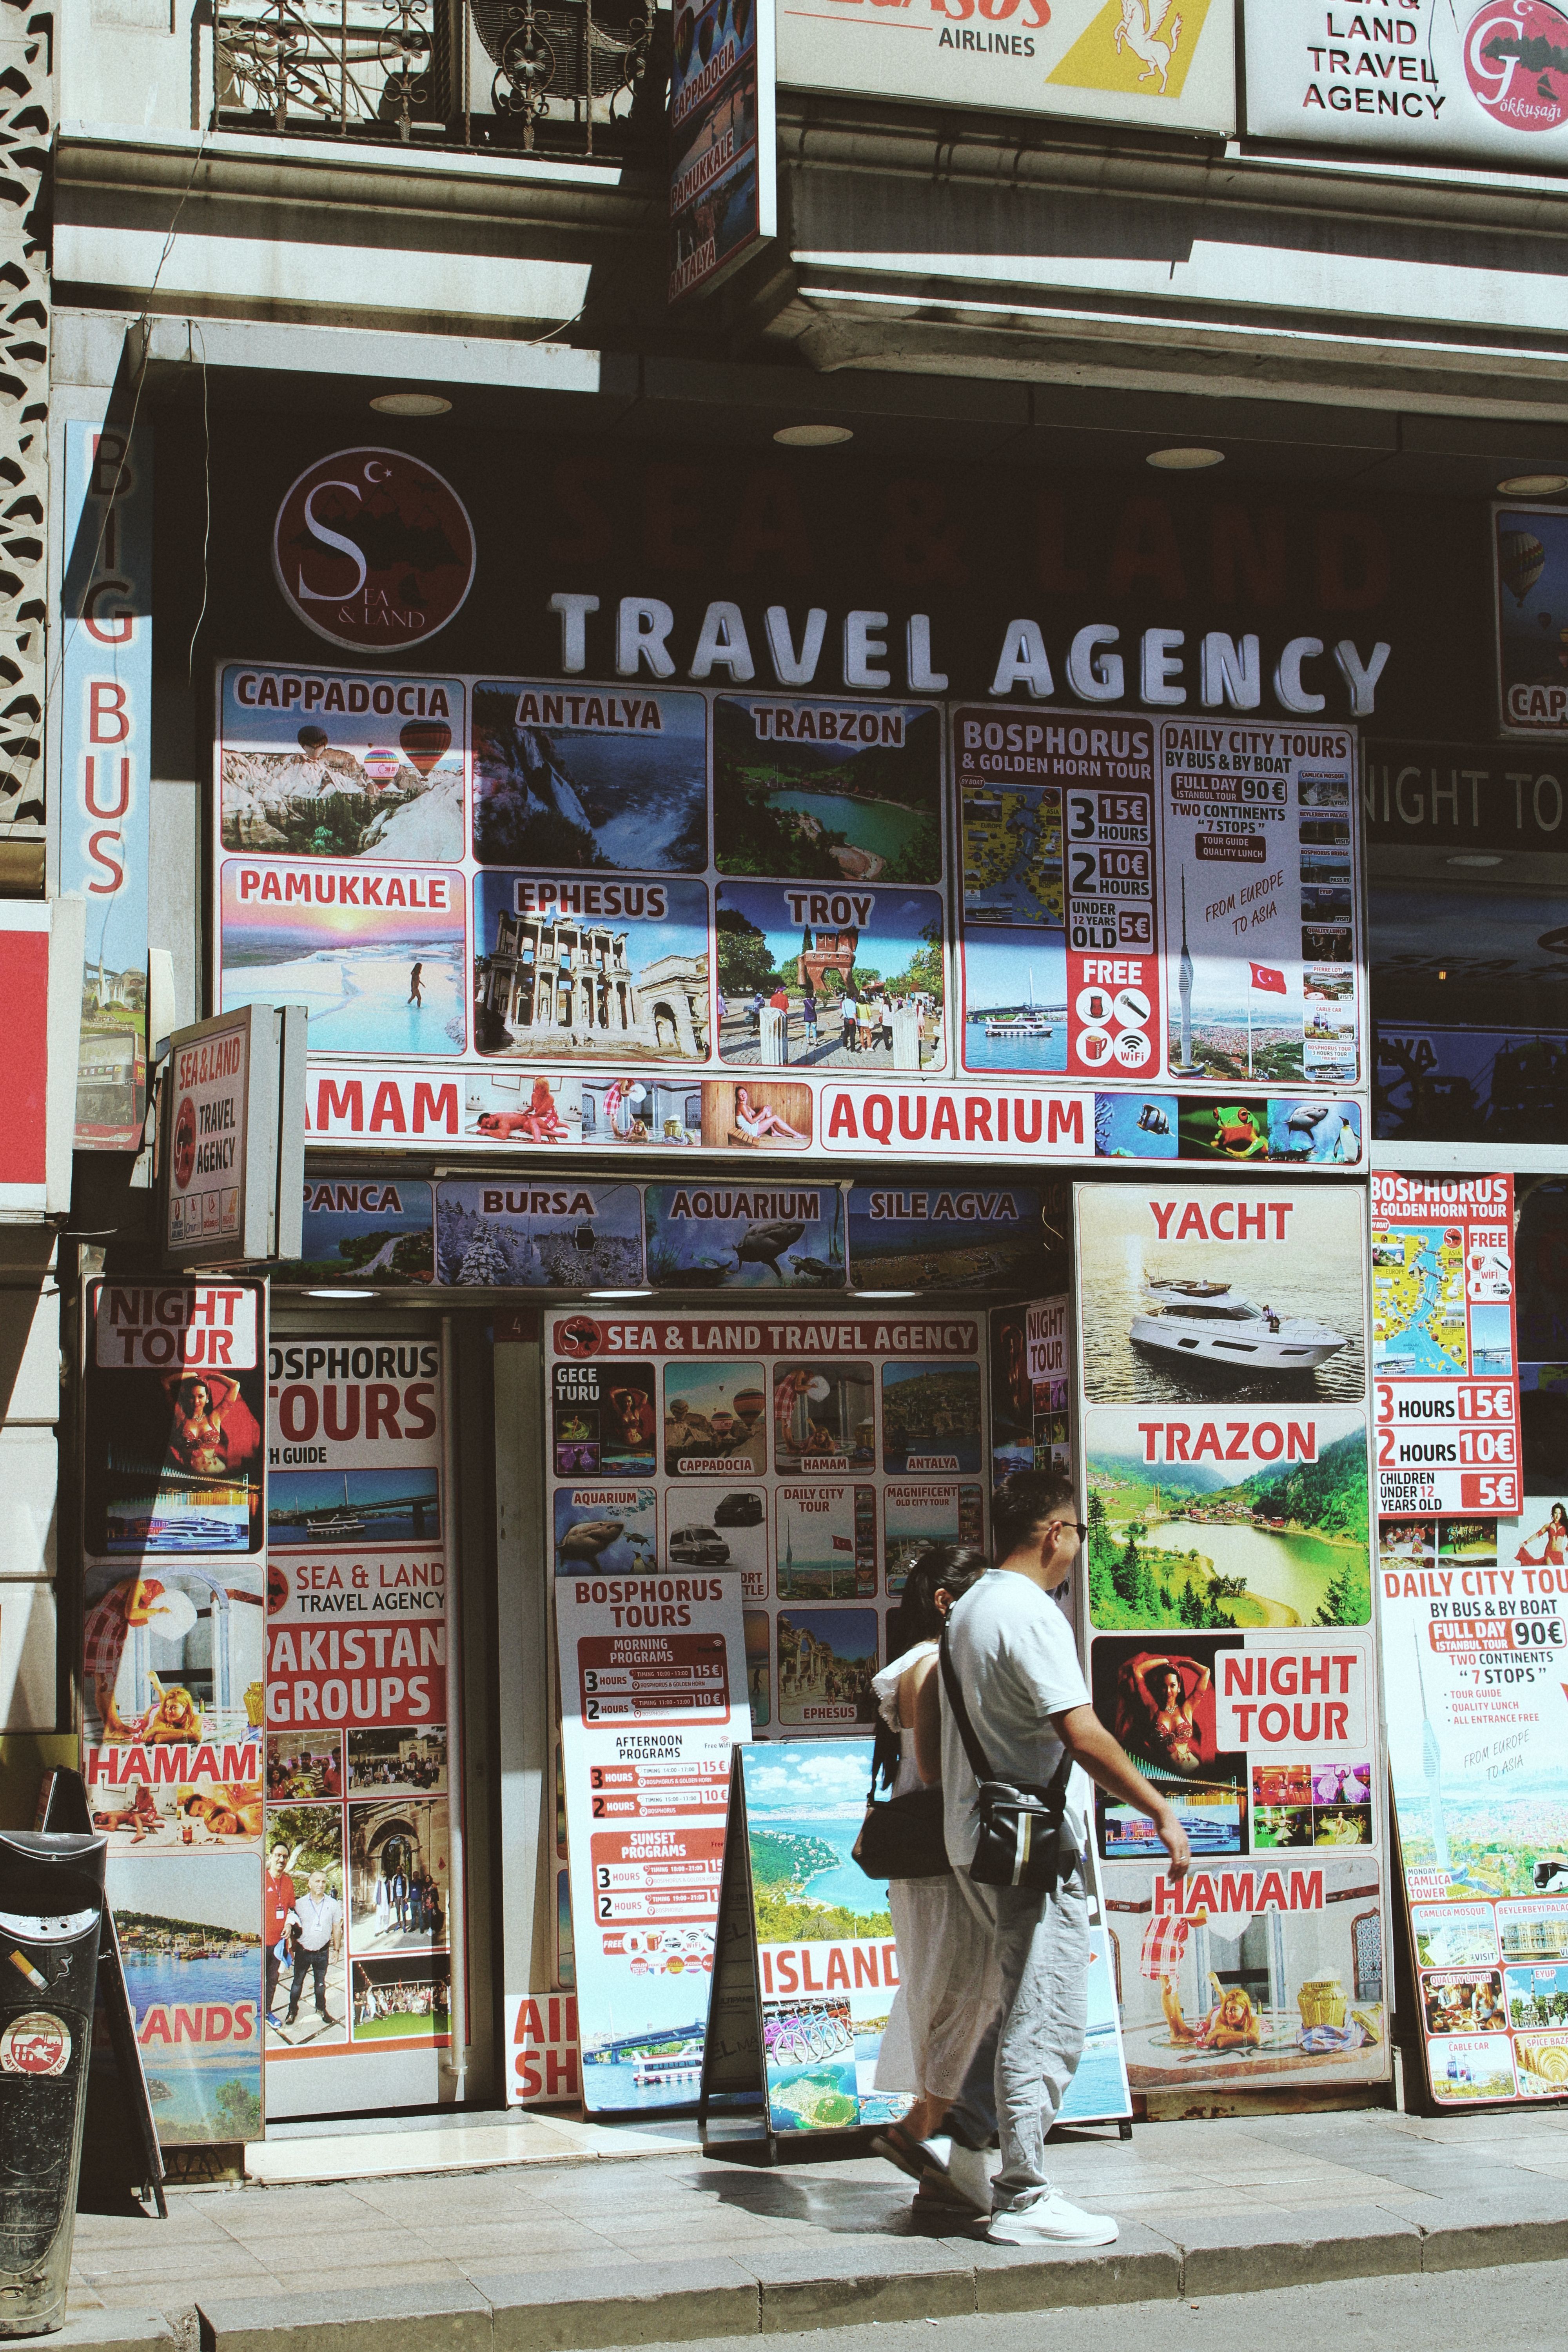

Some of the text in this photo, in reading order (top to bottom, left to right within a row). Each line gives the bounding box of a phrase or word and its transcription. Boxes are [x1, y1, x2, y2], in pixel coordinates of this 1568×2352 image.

[938, 27, 1035, 57] AIRLINES
[1327, 13, 1417, 45] LAND
[1307, 47, 1439, 84] TRAVEL
[672, 39, 735, 125] CAPPADOCIA
[1302, 83, 1446, 120] AGENCY
[670, 130, 734, 216] PAMUKKALE
[668, 238, 716, 303] ANTALYA
[365, 608, 425, 628] LAND
[83, 432, 134, 895] BIG BUS
[547, 592, 1391, 717] TRAVEL AGENCY
[237, 675, 449, 717] CAPPADOCIA
[518, 693, 661, 730] ANTALYA
[753, 707, 902, 745] TRABZON
[964, 721, 1149, 759] BOSPHORUS
[1165, 727, 1347, 759] DAILY CITY TOURS
[962, 753, 1152, 780] & GOLDEN HORN TOUR
[1165, 751, 1292, 774] BY BUS & BY BOAT
[1176, 776, 1237, 791] FULL DAY
[1070, 797, 1095, 838] 3
[1170, 802, 1286, 821] TWO CONTINENTS
[1098, 826, 1148, 842] HOURS
[1072, 852, 1097, 893] 2
[240, 870, 446, 908] PAMUKKALE
[517, 882, 665, 918] EPHESUS
[1100, 880, 1149, 896] HOURS
[1205, 869, 1284, 923] FROM EUROPE
[788, 894, 872, 926] TROY
[1250, 900, 1278, 928] ASIA
[1083, 959, 1143, 985] FREE
[200, 1097, 236, 1136] TRAVEL
[305, 1079, 459, 1134] MAM
[828, 1093, 1084, 1146] AQUARIUM
[196, 1137, 236, 1174] AGENCY
[483, 1191, 592, 1216] BURSA
[1372, 1177, 1507, 1203] BOSPHORUS
[670, 1191, 820, 1220] AQUARIUM
[869, 1192, 1018, 1220] SILE AGVA
[1380, 1203, 1427, 1217] GOLDEN
[1430, 1203, 1468, 1217] HORN
[1470, 1204, 1507, 1218] TOUR
[1148, 1201, 1294, 1240] YACHT
[1470, 1232, 1507, 1247] FREE
[109, 1288, 243, 1326] NIGHT
[608, 1325, 974, 1350] SEA & LAND TRAVEL AGENCY
[1028, 1307, 1065, 1341] NIGHT
[116, 1328, 233, 1365] TOUR
[1030, 1340, 1063, 1373] TOUR
[269, 1346, 439, 1380] OSPHORUS
[557, 1368, 597, 1383] GECE
[556, 1385, 600, 1401] TURU
[1377, 1384, 1394, 1423] 3
[1399, 1400, 1455, 1418] HOURS
[1138, 1422, 1316, 1461] TRAZON
[1378, 1428, 1396, 1466] 2
[1400, 1444, 1456, 1462] HOURS
[283, 1448, 327, 1465] GUIDE
[679, 1459, 752, 1471] CAPPADOCIA
[803, 1459, 847, 1470] HAMAM
[908, 1457, 958, 1469] ANTALYA
[1380, 1472, 1435, 1485] CHILDREN
[1380, 1486, 1434, 1498] UNDER 12
[574, 1492, 637, 1505] AQUARIUM
[1381, 1499, 1442, 1511] YEARS OLD
[296, 1563, 445, 1590] SEA & LAND
[1384, 1572, 1453, 1598] DAILY
[1461, 1569, 1515, 1597] CITY
[297, 1592, 445, 1612] TRAVEL AGENCY
[575, 1579, 723, 1604] BOSPHORUS
[610, 1604, 691, 1628] TOURS
[1430, 1599, 1557, 1618] BY BUS & BY BOAT
[1433, 1622, 1474, 1639] FULL
[1475, 1621, 1506, 1638] DAY
[267, 1627, 445, 1672] AKISTAN
[610, 1650, 673, 1664] PROGRAMS
[614, 1638, 668, 1651] MORNING
[1436, 1639, 1508, 1651] ISTANBUL TOUR
[1449, 1651, 1553, 1666] TWO CONTINENTS
[1224, 1655, 1357, 1697] NIGHT
[267, 1675, 430, 1723] GROUPS
[804, 1707, 855, 1719] EPHESUS
[1231, 1702, 1349, 1743] TOUR
[616, 1735, 683, 1748] AFTERNOON
[619, 1748, 681, 1760] PROGRAMS
[89, 1744, 257, 1784] HAMAM
[621, 1844, 687, 1859] PROGRAMS
[630, 1832, 676, 1845] SUNSET
[1154, 1870, 1323, 1915] HAMAM
[1407, 1875, 1451, 1889] ÇAMLICA
[1410, 1888, 1446, 1899] TOWER
[603, 1940, 623, 1948] FREE
[1430, 1973, 1491, 1986] QUALITY LUNCH
[1535, 1969, 1555, 1978] EYUP
[138, 2004, 253, 2044] ANDS
[1448, 2042, 1489, 2052] CABLE CAR
